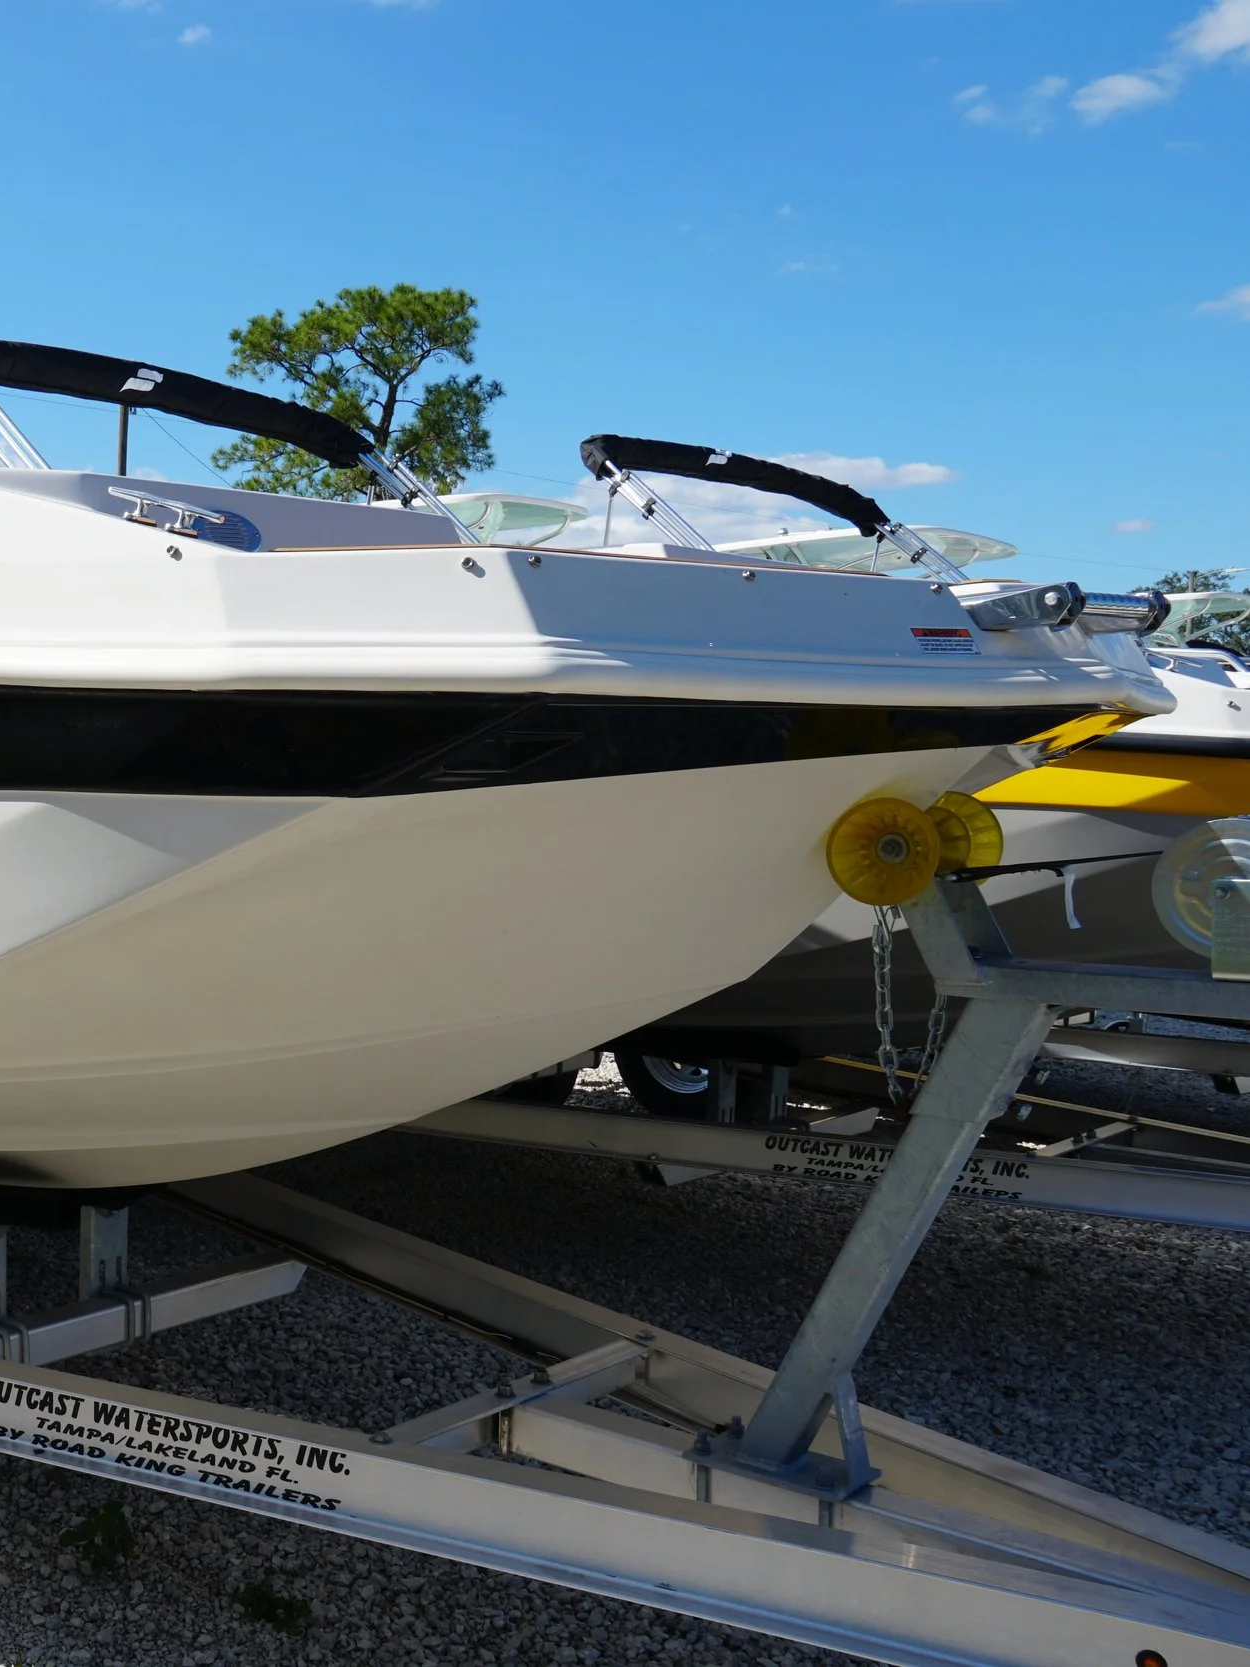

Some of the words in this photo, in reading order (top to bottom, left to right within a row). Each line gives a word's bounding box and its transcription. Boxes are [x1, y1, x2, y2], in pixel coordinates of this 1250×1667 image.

[764, 1136, 843, 1157] OUTCAST
[992, 1160, 1030, 1179] INC.
[772, 1163, 798, 1173] BY
[802, 1167, 857, 1180] ROAD
[36, 1417, 256, 1473] TAMPA/LAKELAND
[265, 1466, 299, 1484] FL.
[93, 1401, 285, 1465] WATERSPORTS,
[295, 1444, 350, 1476] INC.
[31, 1434, 106, 1458] ROAD
[114, 1452, 186, 1476] KING
[197, 1469, 342, 1511] TRAILERS
